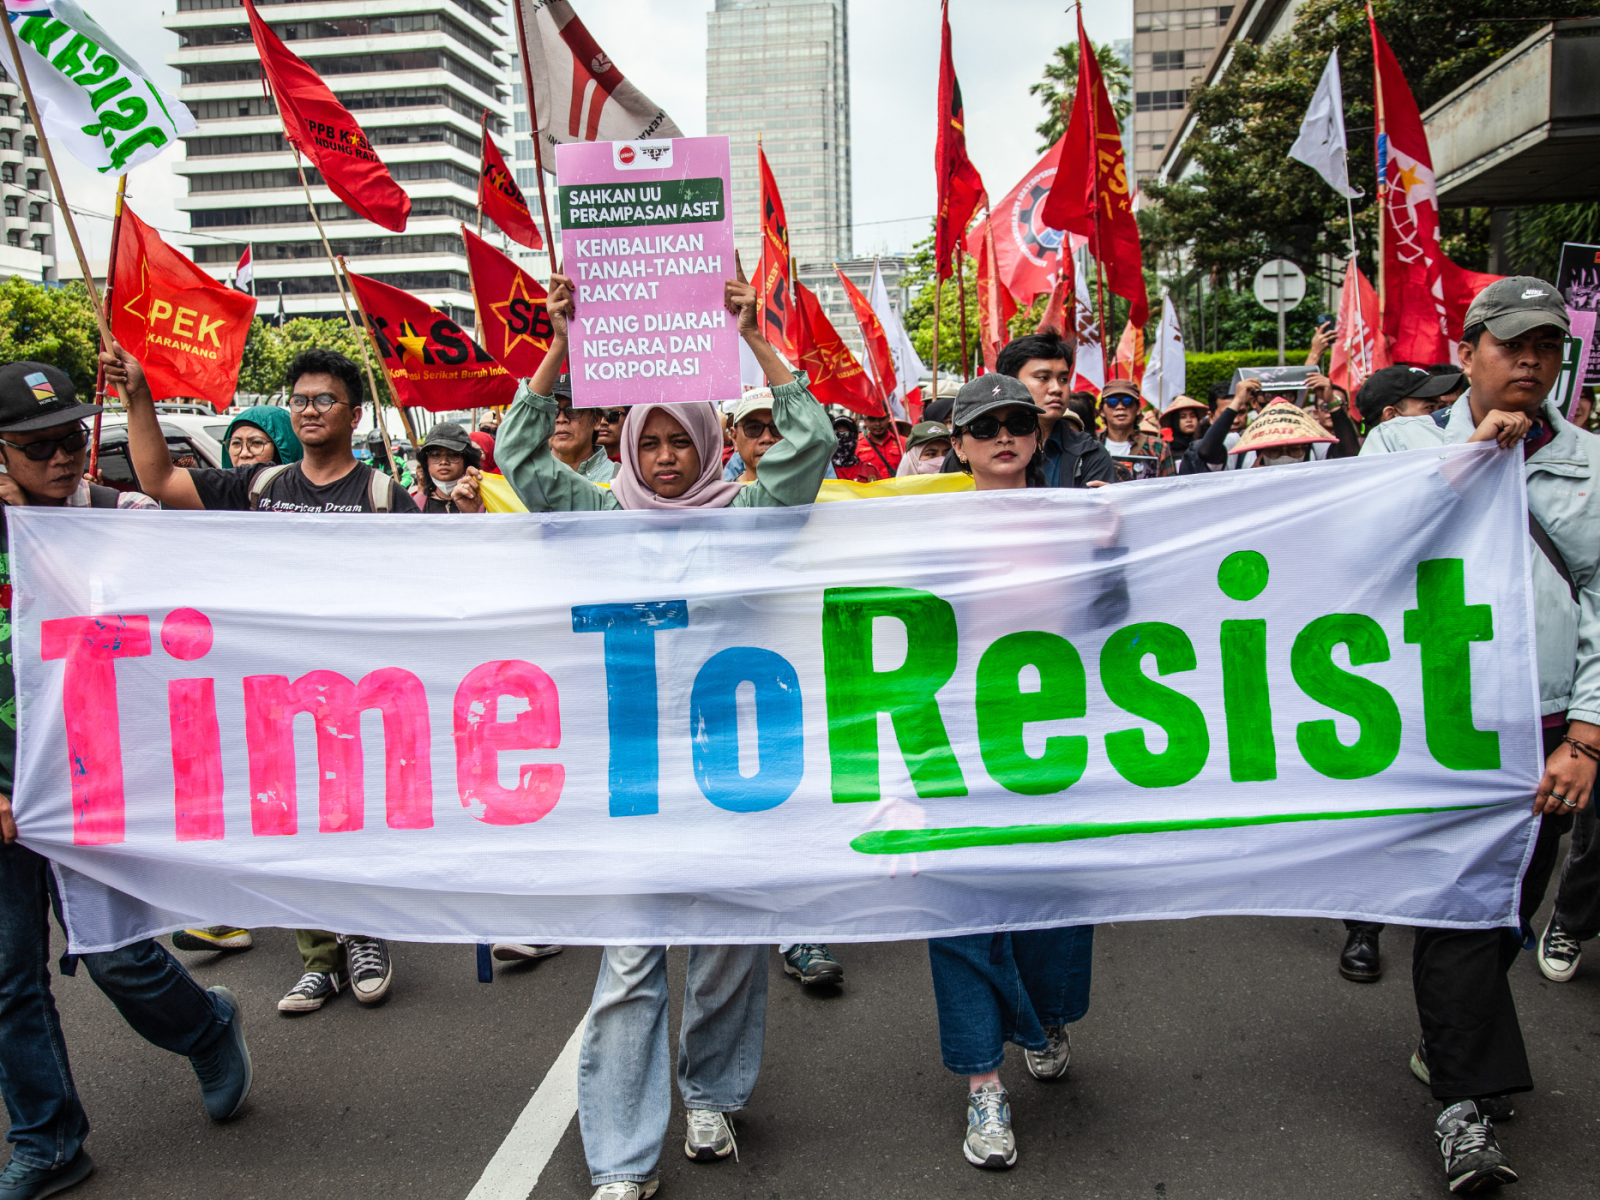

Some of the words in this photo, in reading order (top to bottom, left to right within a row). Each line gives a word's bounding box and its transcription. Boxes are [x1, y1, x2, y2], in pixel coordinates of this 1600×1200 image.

[304, 118, 335, 139] PPB
[356, 148, 380, 164] RAYA
[569, 188, 636, 205] SAHKAN
[640, 186, 662, 202] UU
[570, 204, 677, 223] PERAMPASAN
[681, 201, 720, 218] ASET
[576, 234, 704, 258] KEMBALIKAN
[577, 255, 722, 280] TANAH-TANAH
[580, 281, 659, 303] RAKYAT
[581, 315, 639, 335] YANG
[644, 311, 726, 332] DIJARAH
[147, 333, 217, 359] KARAWANG
[583, 337, 664, 358] NEGARA
[670, 334, 711, 353] DAN
[423, 370, 458, 380] Serikat
[461, 367, 488, 379] Buruh
[585, 357, 700, 381] KORPORASI
[272, 500, 322, 513] American
[324, 502, 362, 512] Dream
[41, 607, 565, 846] Time
[571, 599, 804, 818] To
[822, 550, 1501, 804] Resist
